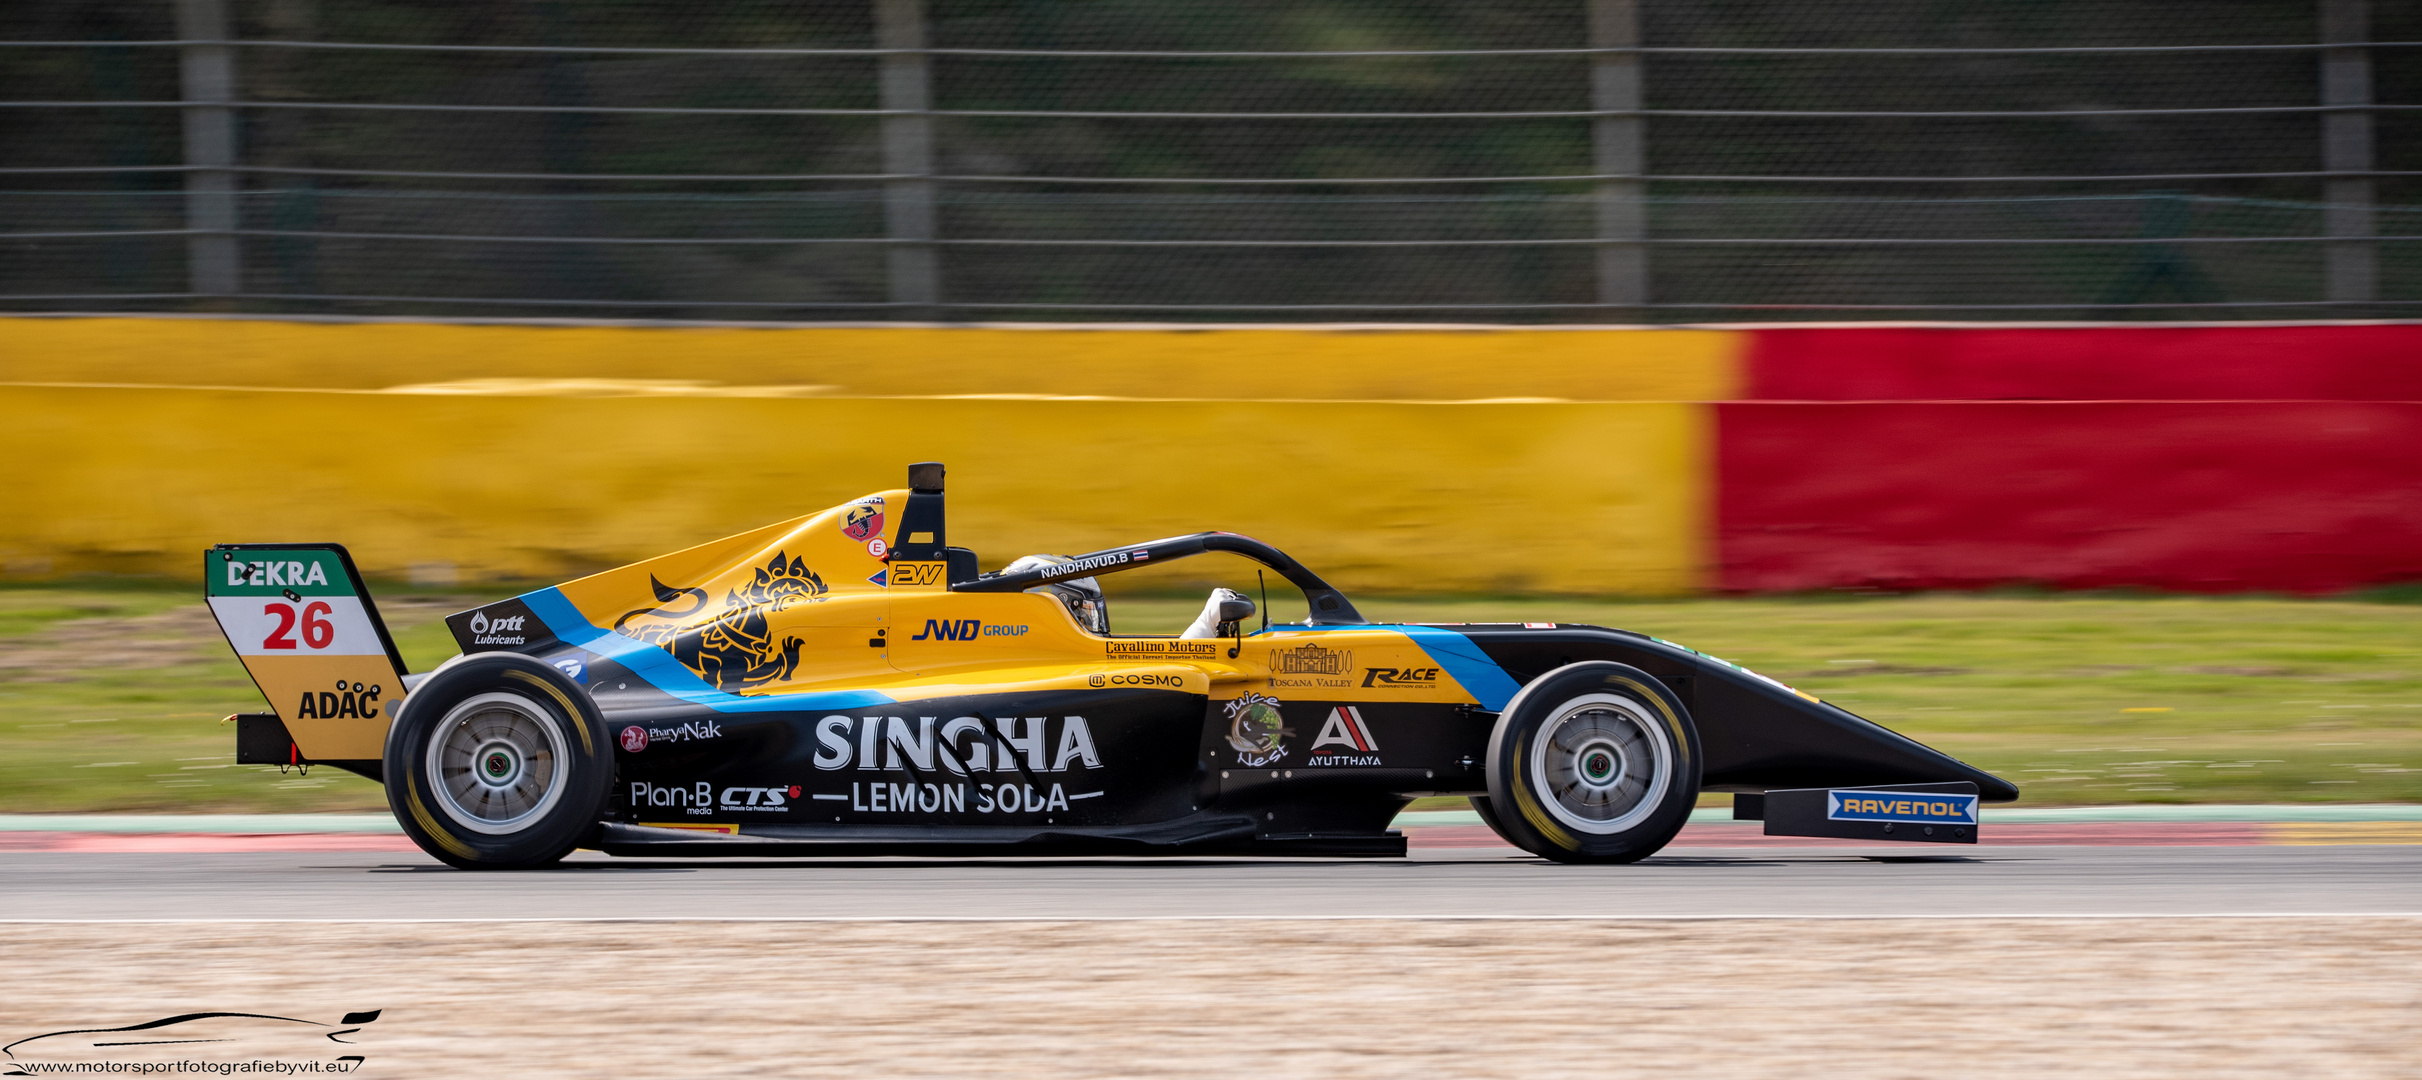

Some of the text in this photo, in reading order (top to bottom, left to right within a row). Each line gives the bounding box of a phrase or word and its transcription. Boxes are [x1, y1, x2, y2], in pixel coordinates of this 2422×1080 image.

[873, 543, 882, 553] E
[227, 560, 328, 586] DEKRA
[1041, 553, 1128, 579] NANDHAVUD.B
[263, 601, 334, 649] 26
[490, 615, 525, 634] ptt
[911, 619, 1029, 641] JWD GROUP
[475, 634, 525, 645] Lubricants
[1106, 641, 1216, 653] Cavallino Motors
[1111, 675, 1183, 687] COSMO
[1361, 668, 1439, 688] RACE
[298, 691, 379, 719] ADAC
[813, 715, 1104, 777] SINGHA
[1237, 745, 1288, 767] Nest
[1308, 756, 1381, 766] AYUTTHAYA
[853, 782, 1069, 812] LEMON SODA
[687, 807, 712, 815] media
[1844, 799, 1962, 816] RAVENOL
